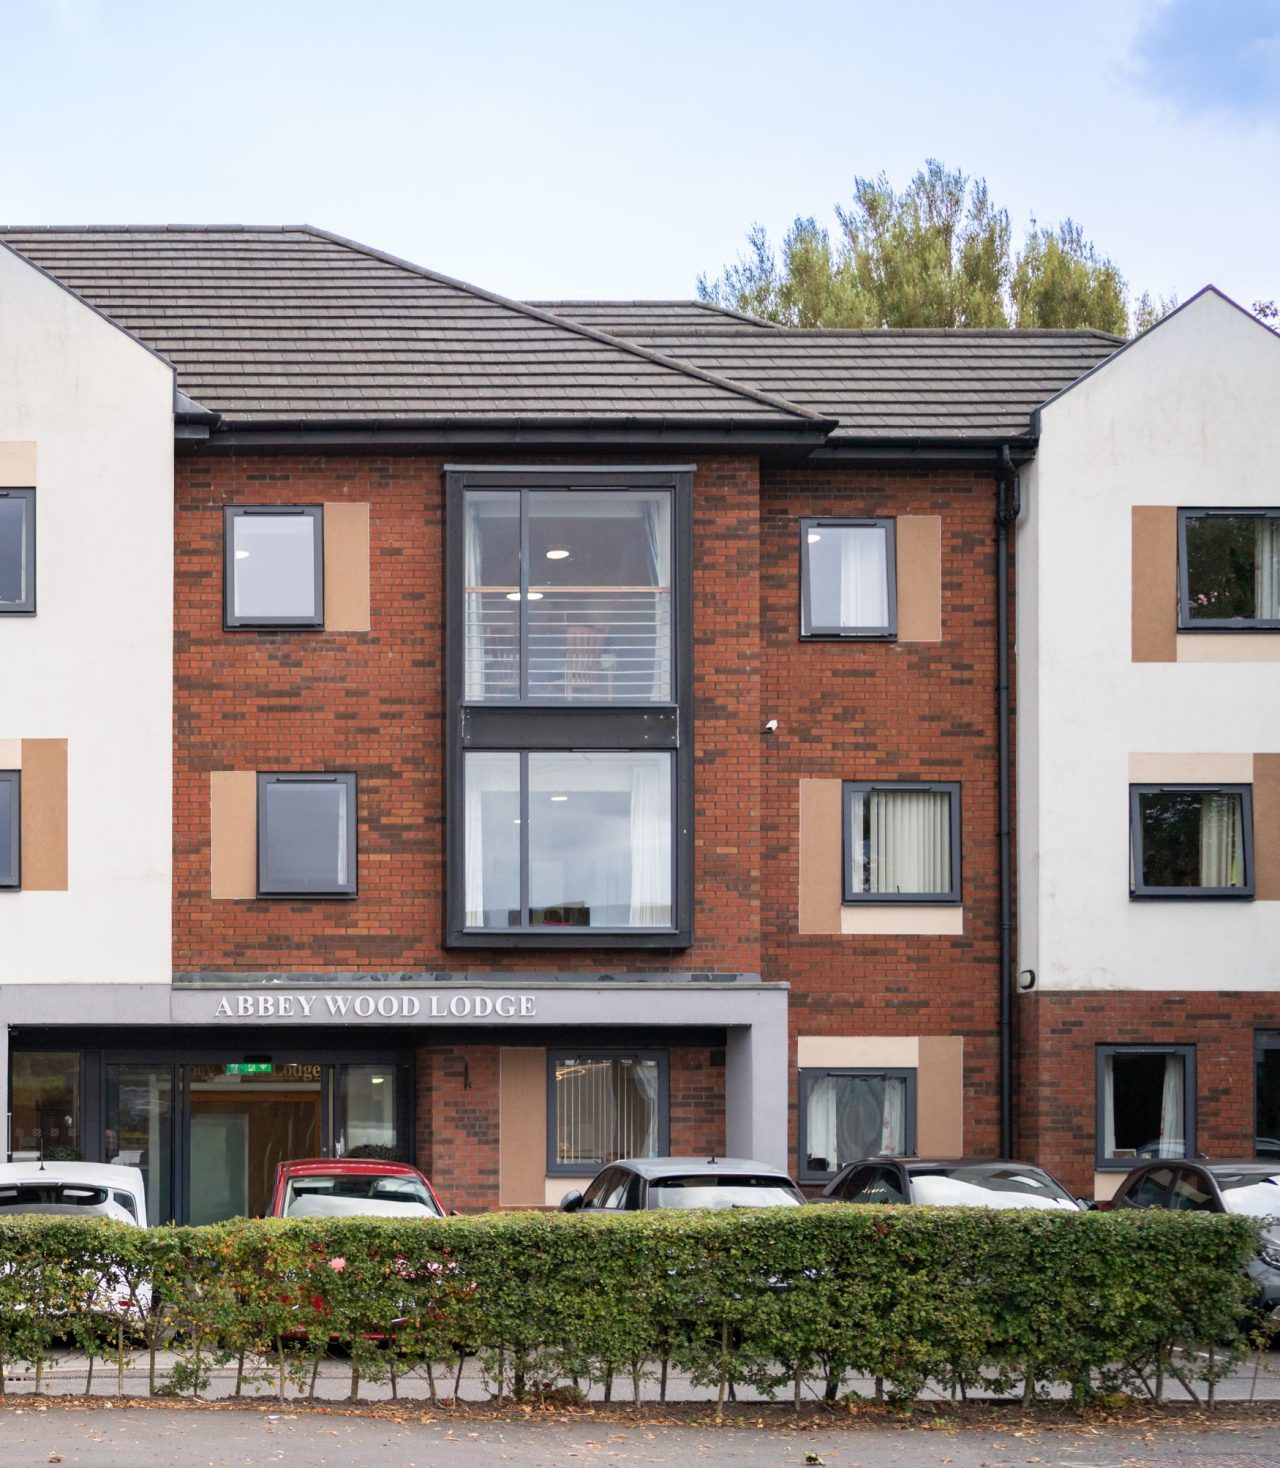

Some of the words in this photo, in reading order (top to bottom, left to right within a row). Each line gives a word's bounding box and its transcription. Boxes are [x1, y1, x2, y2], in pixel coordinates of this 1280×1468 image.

[215, 995, 318, 1017] ABBEY
[324, 995, 420, 1017] WOOD
[429, 995, 537, 1017] LODGE
